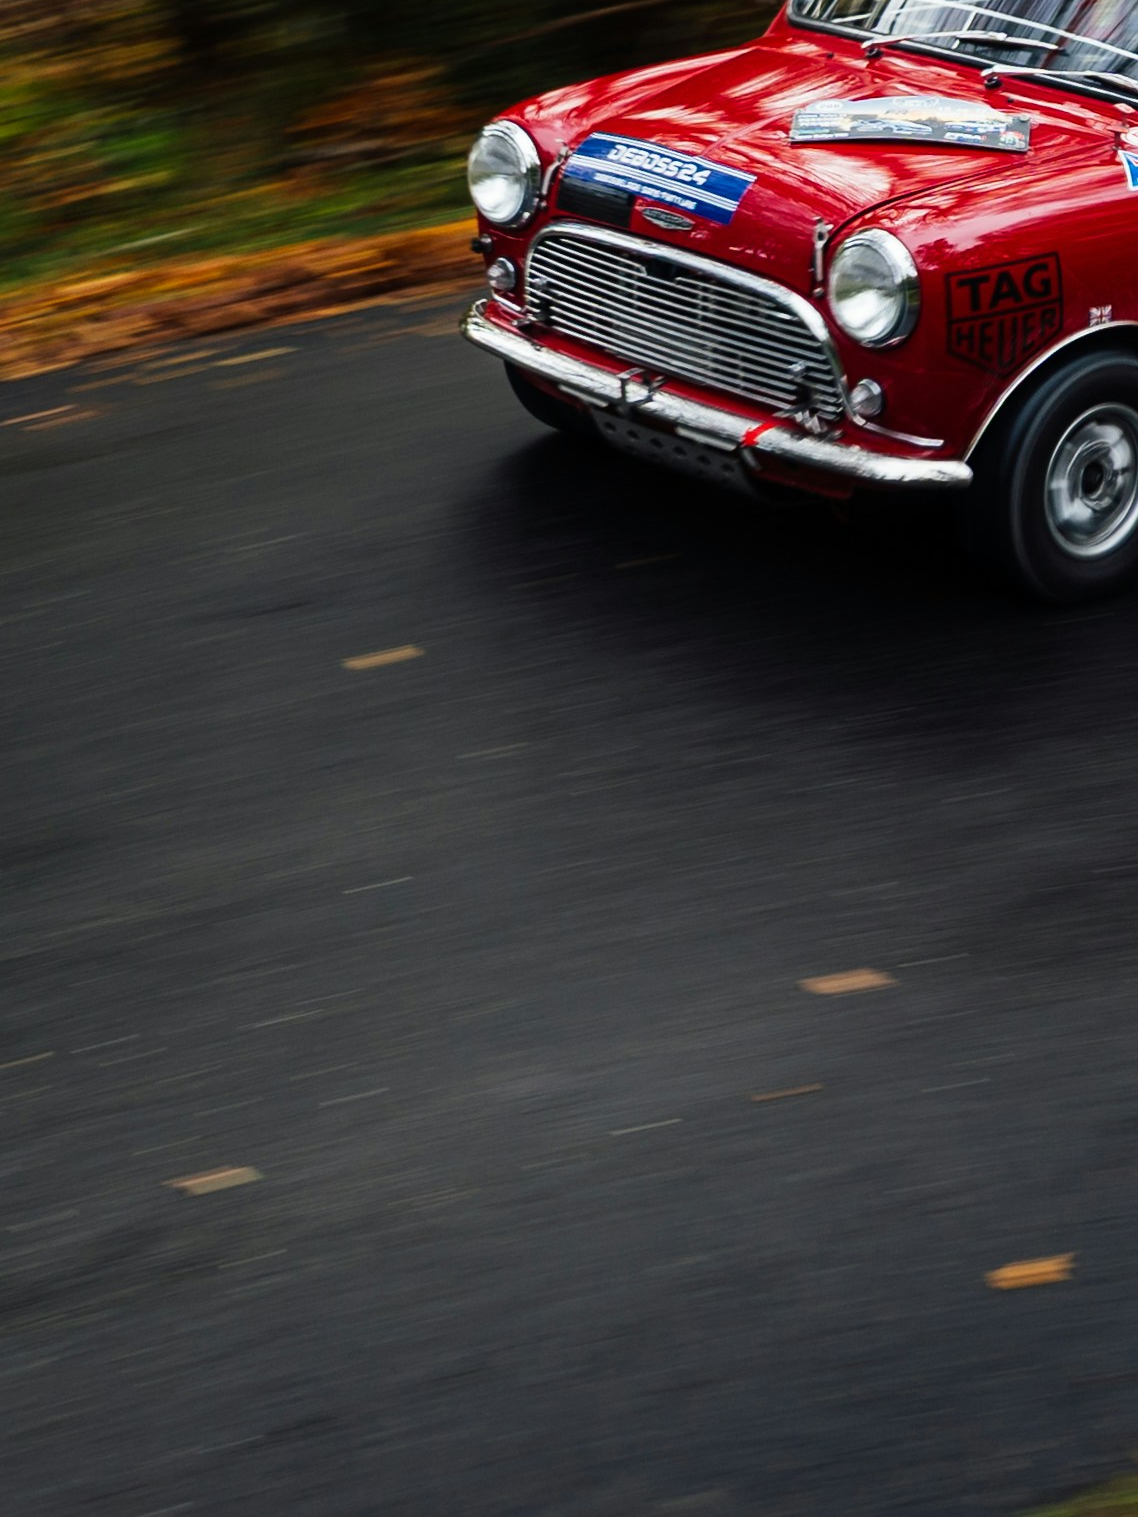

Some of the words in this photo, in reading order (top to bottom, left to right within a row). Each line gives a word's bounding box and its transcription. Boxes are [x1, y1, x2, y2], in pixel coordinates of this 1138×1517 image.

[606, 144, 712, 185] DEBOSS24
[957, 263, 1052, 312] TAG
[955, 307, 1057, 369] HEUER
